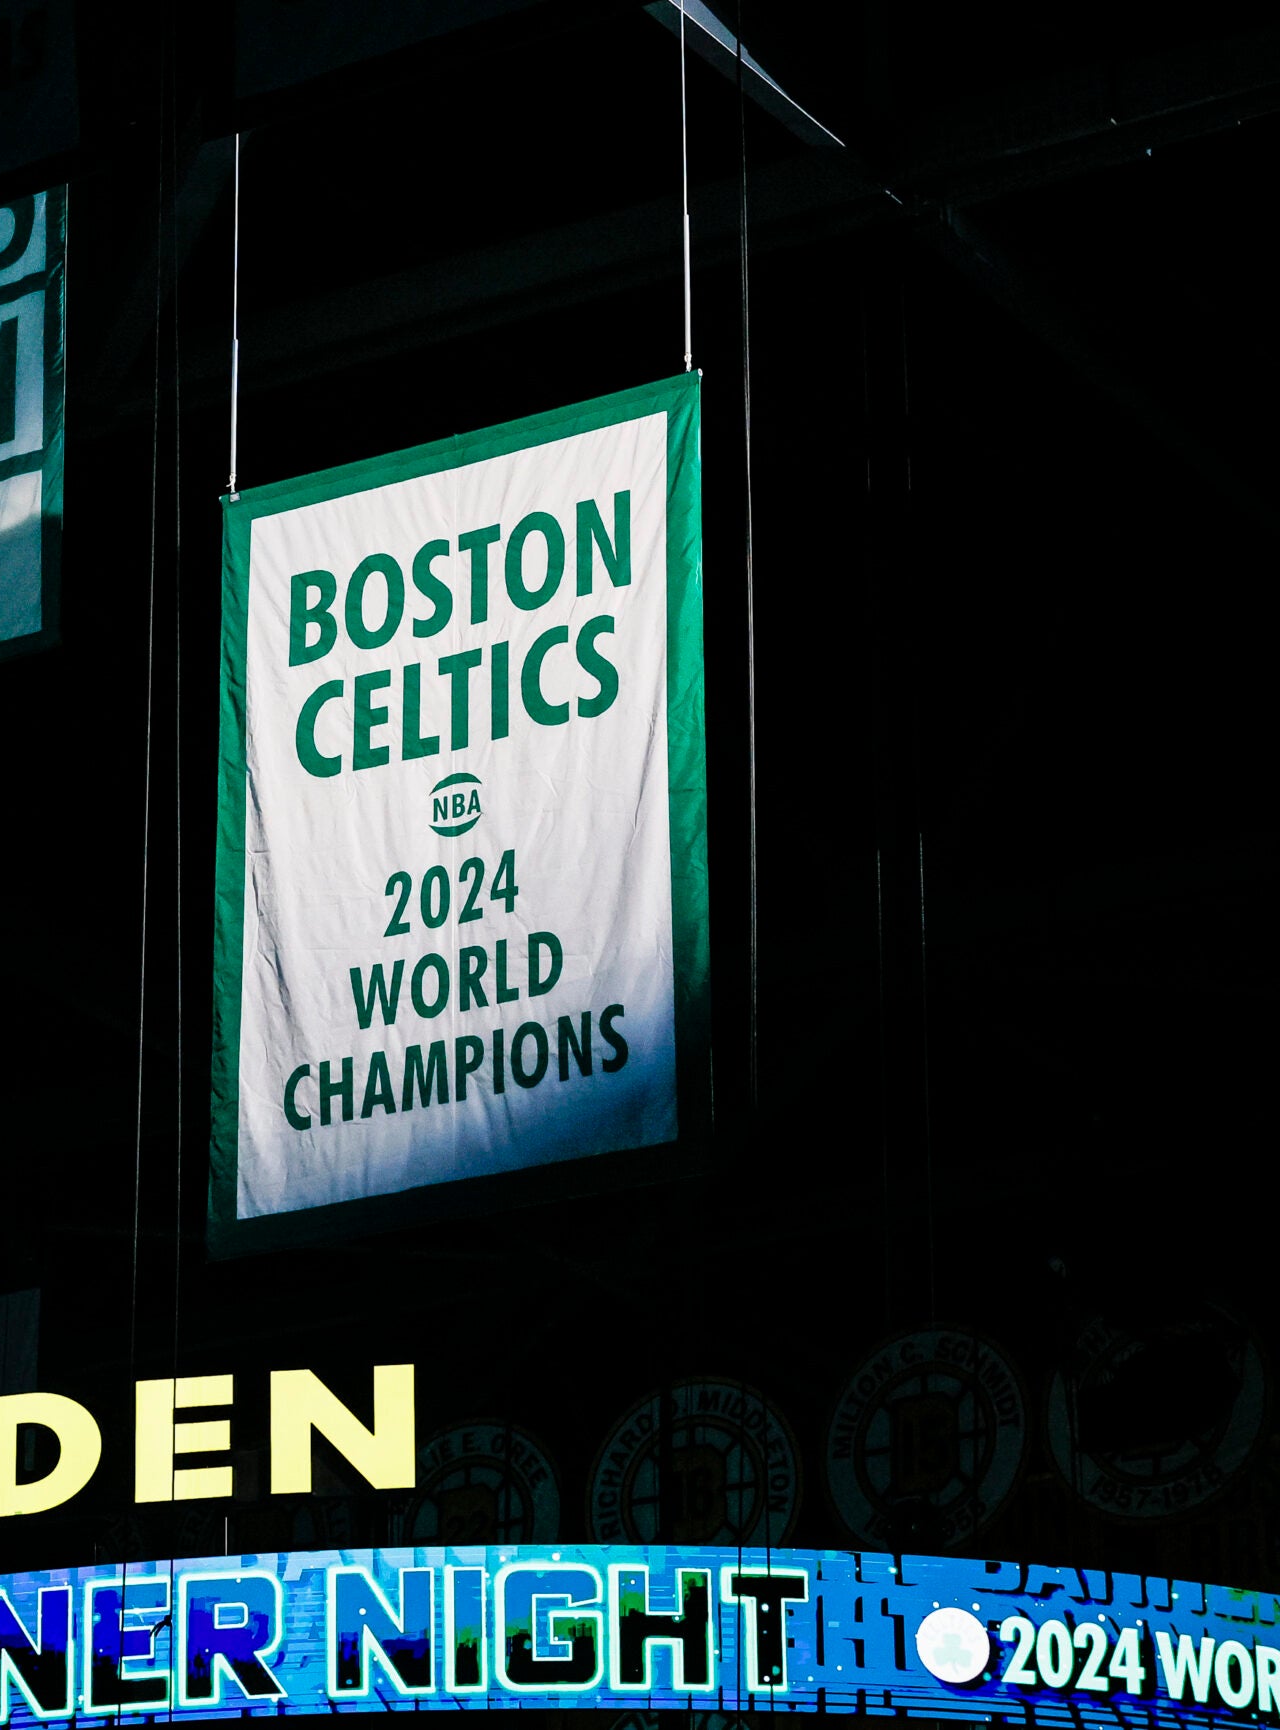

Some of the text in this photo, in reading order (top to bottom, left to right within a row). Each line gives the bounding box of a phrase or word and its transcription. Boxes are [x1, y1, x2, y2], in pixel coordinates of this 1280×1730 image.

[289, 490, 631, 667] BOSTON
[295, 615, 619, 778] CELTICS
[433, 789, 481, 822] NBA
[384, 849, 519, 937] 2024
[349, 931, 564, 1030] WORLD
[283, 1004, 629, 1131] CHAMPIONS
[598, 1413, 653, 1540] RICHARD
[327, 1562, 809, 1698] NIGHT
[999, 1616, 1145, 1695] 2024
